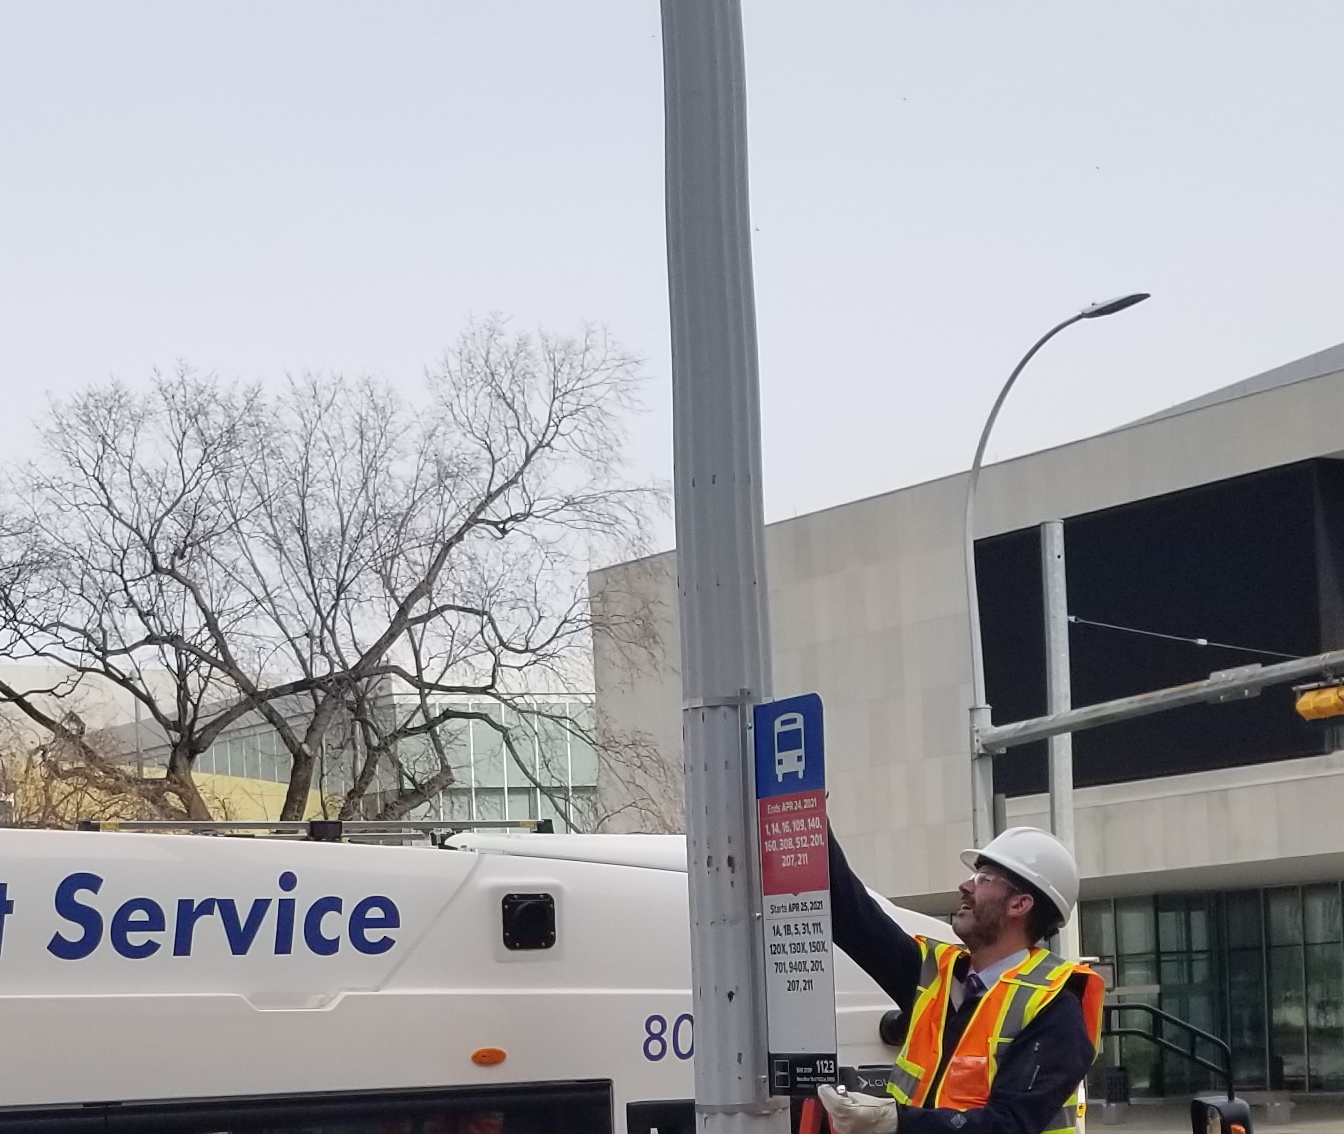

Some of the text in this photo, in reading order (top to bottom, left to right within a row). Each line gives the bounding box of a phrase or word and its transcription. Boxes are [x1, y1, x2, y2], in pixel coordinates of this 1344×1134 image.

[767, 804, 781, 814] Ends
[782, 801, 794, 812] APR
[803, 797, 817, 809] 2021
[771, 822, 781, 834] 14,
[792, 819, 807, 831] 109,
[808, 816, 822, 829] 140,
[779, 838, 794, 850] 308,
[795, 836, 809, 848] 512,
[810, 834, 824, 846] 201,
[782, 852, 808, 867] 207, 211
[770, 900, 824, 914] Starts APR 25, 2021
[46, 869, 401, 961] Service
[772, 921, 824, 937] 1A, 1B, 5, 31, 111,
[769, 941, 828, 955] 120X, 130X, 150X,
[774, 960, 825, 974] 701, 940X, 201,
[787, 979, 814, 993] 207, 211
[816, 1060, 835, 1074] 1123
